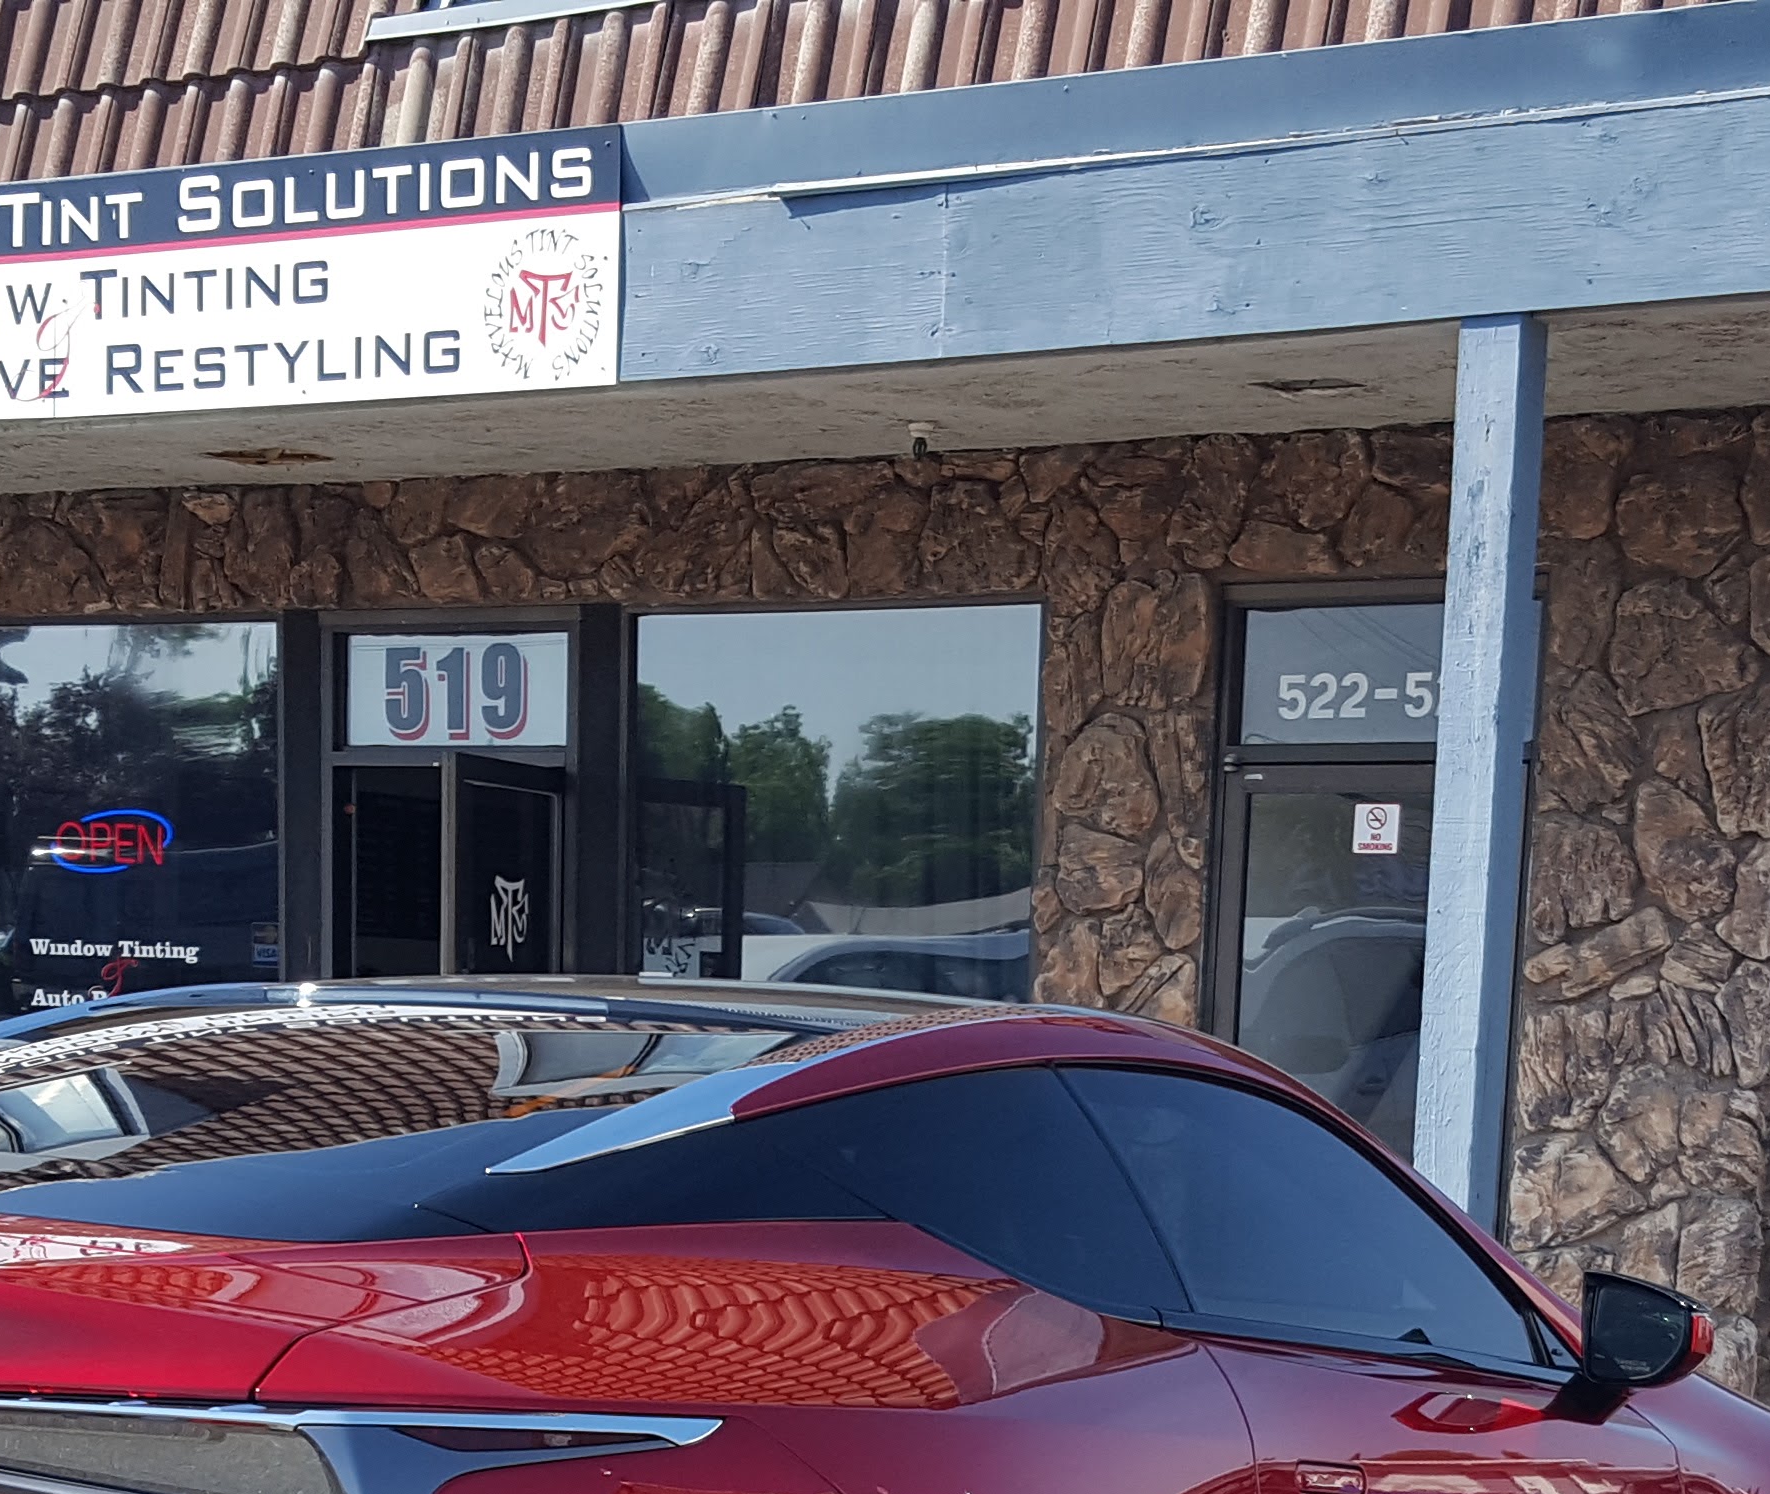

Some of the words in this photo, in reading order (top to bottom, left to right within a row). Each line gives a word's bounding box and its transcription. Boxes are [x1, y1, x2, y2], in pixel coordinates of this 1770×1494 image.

[178, 146, 595, 232] SOLUTIONS
[79, 259, 330, 319] TINTING
[105, 329, 462, 395] RESTYLING
[384, 641, 528, 742] 519
[1278, 672, 1441, 719] 522-5
[56, 820, 165, 866] OPEN
[30, 938, 114, 957] Window
[118, 940, 200, 964] Tinting
[30, 988, 86, 1007] Auto
